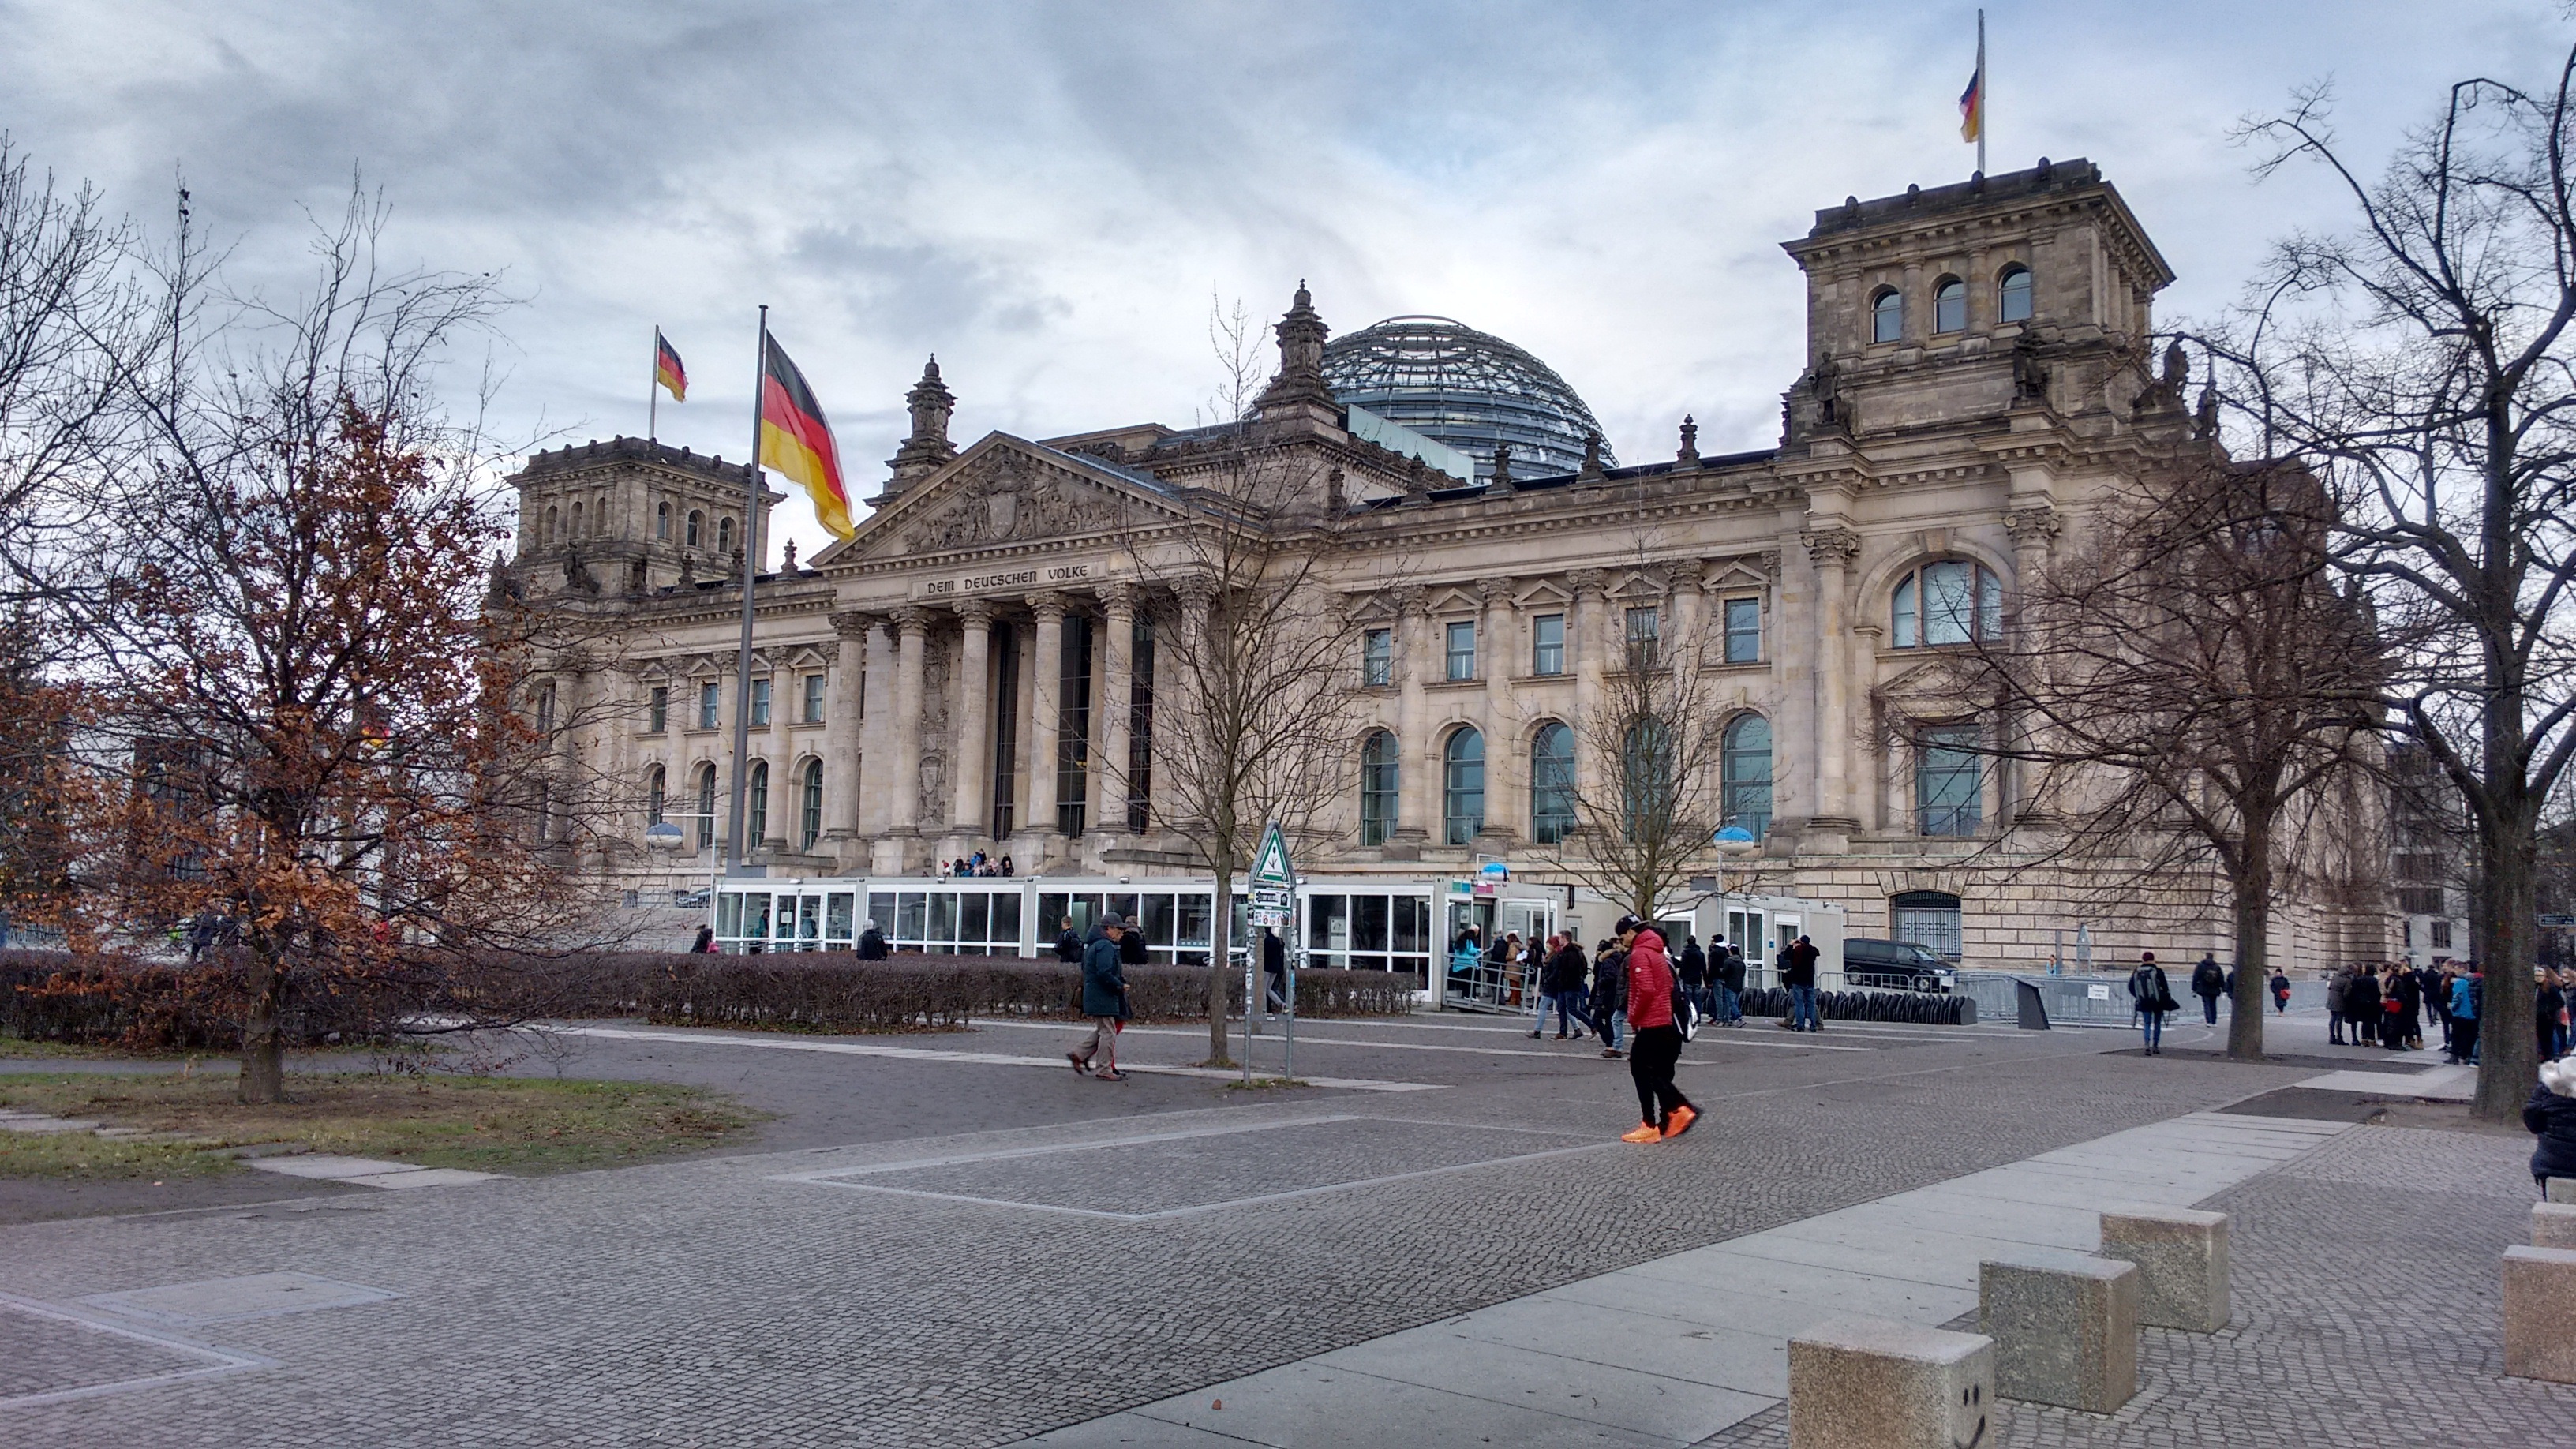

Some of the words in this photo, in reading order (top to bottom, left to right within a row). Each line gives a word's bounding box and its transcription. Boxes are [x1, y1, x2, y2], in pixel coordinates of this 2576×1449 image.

[928, 581, 954, 593] DEM
[964, 571, 1037, 590] DEUTSCHEN
[1048, 565, 1088, 580] VOLKE
